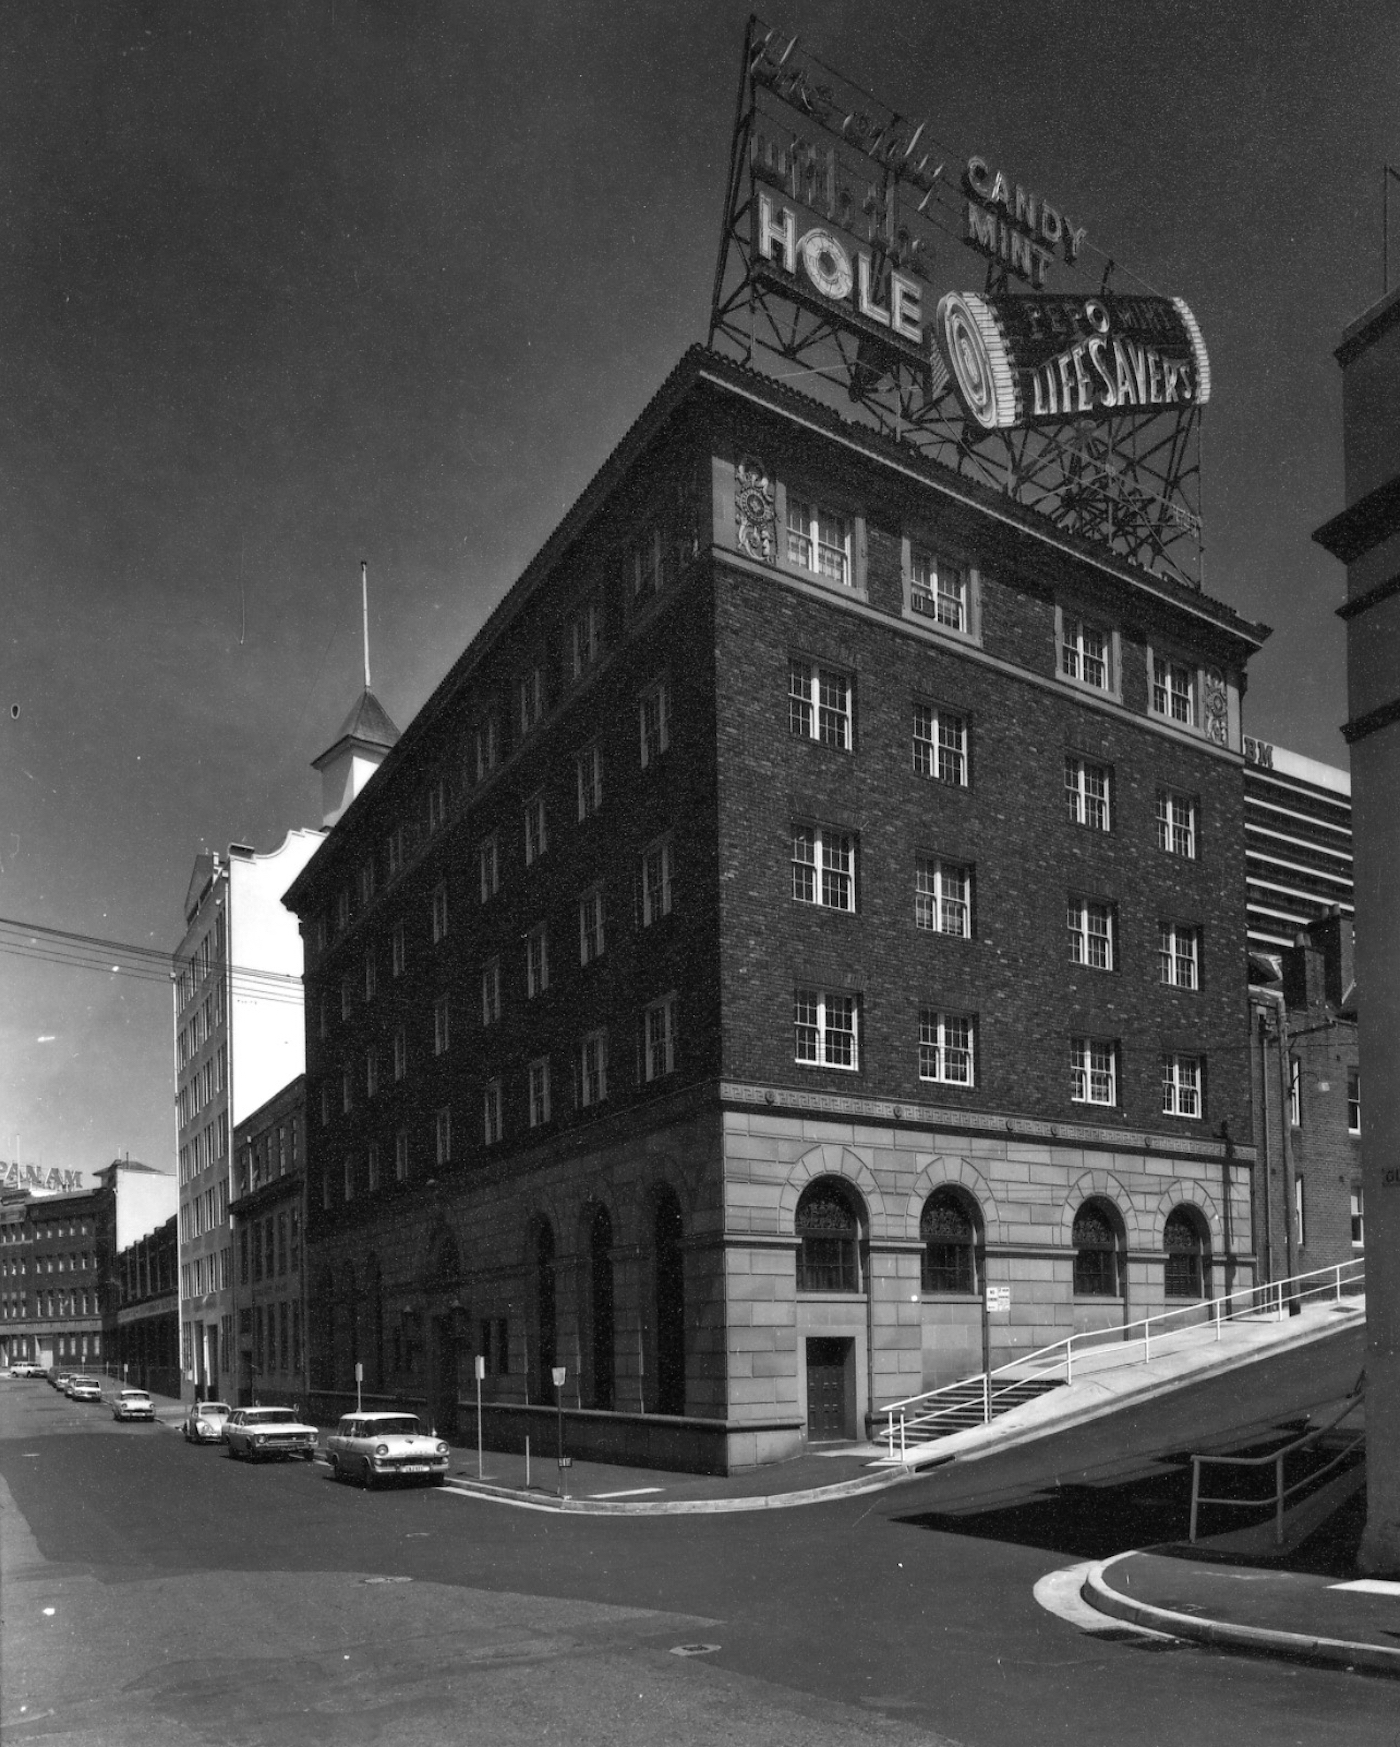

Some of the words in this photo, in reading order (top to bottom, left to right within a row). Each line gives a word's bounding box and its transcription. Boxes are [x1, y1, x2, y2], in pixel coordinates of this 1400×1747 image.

[966, 155, 1088, 258] CANDY
[968, 201, 1054, 284] MINT
[759, 190, 924, 345] HOLE
[1032, 345, 1093, 416] LIFE
[1088, 336, 1192, 408] SAVERS
